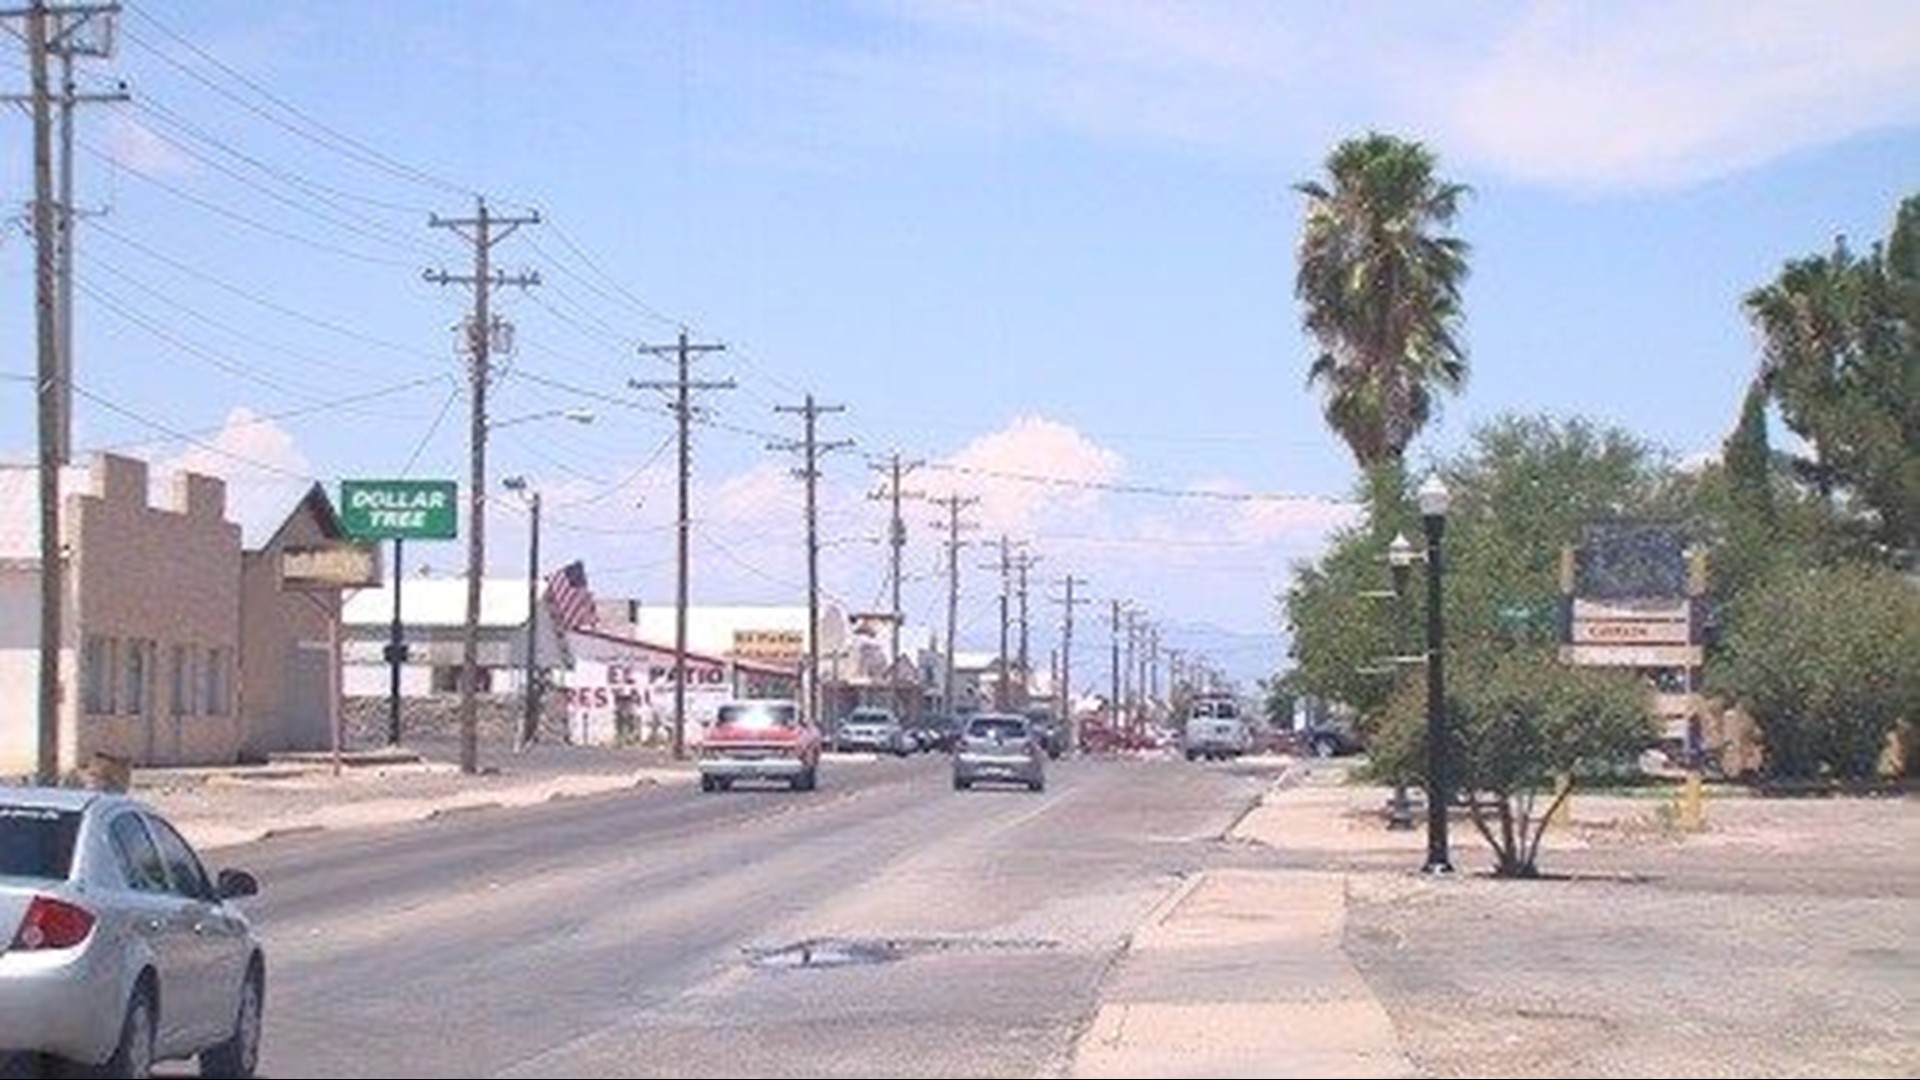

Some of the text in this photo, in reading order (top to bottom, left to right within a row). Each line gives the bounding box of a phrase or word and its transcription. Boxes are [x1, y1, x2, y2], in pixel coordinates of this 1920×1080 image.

[352, 490, 445, 509] DOLLAR
[368, 510, 427, 528] TREE
[607, 664, 724, 685] EL PATIO
